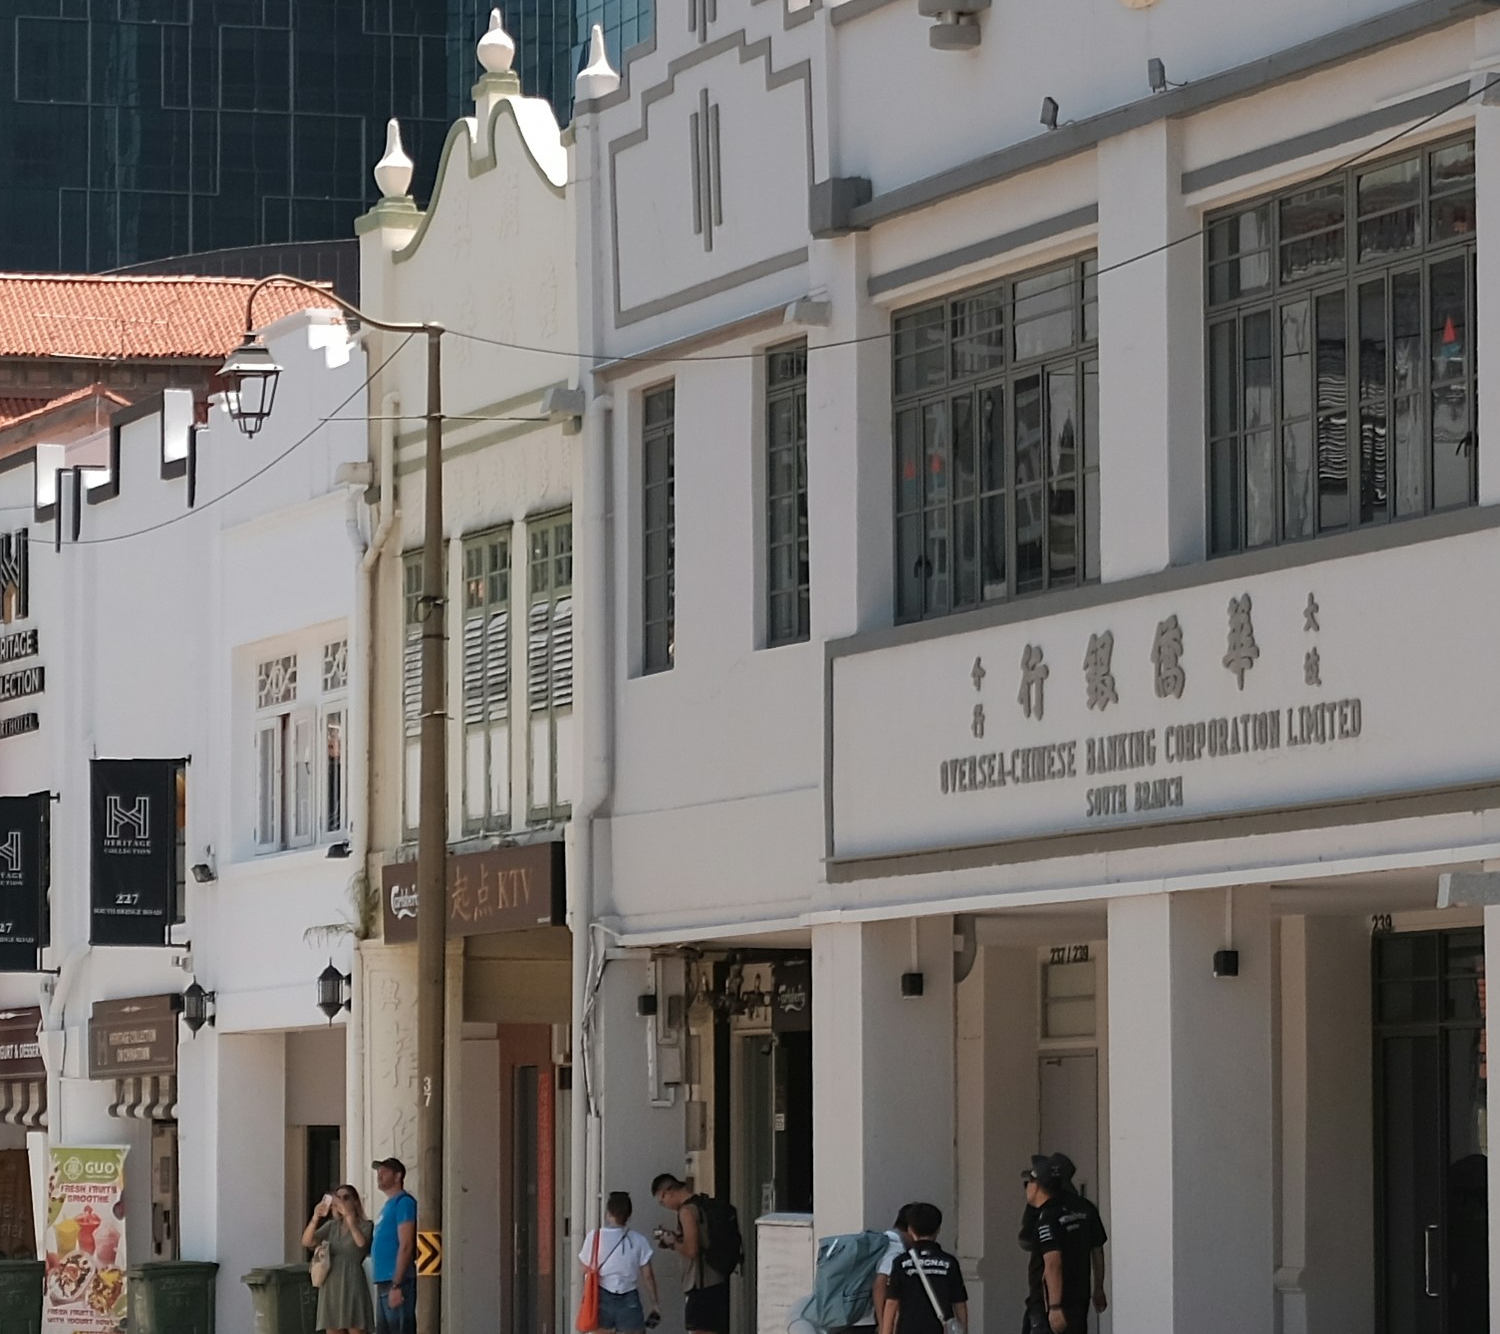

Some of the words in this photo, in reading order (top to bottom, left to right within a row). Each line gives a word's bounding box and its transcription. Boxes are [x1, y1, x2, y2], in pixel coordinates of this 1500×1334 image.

[940, 739, 1076, 795] OVERSEA-CHINESE
[1085, 728, 1157, 776] BANKING
[1164, 708, 1281, 765] CORPORATION
[1286, 697, 1362, 747] LIMITED
[1086, 784, 1128, 818] SOUTH
[1134, 775, 1184, 811] BRANCH
[104, 839, 151, 847] HERITAGE
[497, 868, 533, 909] KTV
[115, 893, 140, 905] 227
[1371, 914, 1393, 933] 239
[14, 1044, 19, 1058] &
[423, 1076, 432, 1107] 37
[84, 1161, 115, 1174] GUO
[60, 1184, 86, 1193] FRESH
[88, 1185, 118, 1194] FRUITS
[67, 1194, 110, 1203] SMOOTHIE
[47, 1308, 68, 1316] FRESH
[67, 1317, 93, 1325] YOGURT
